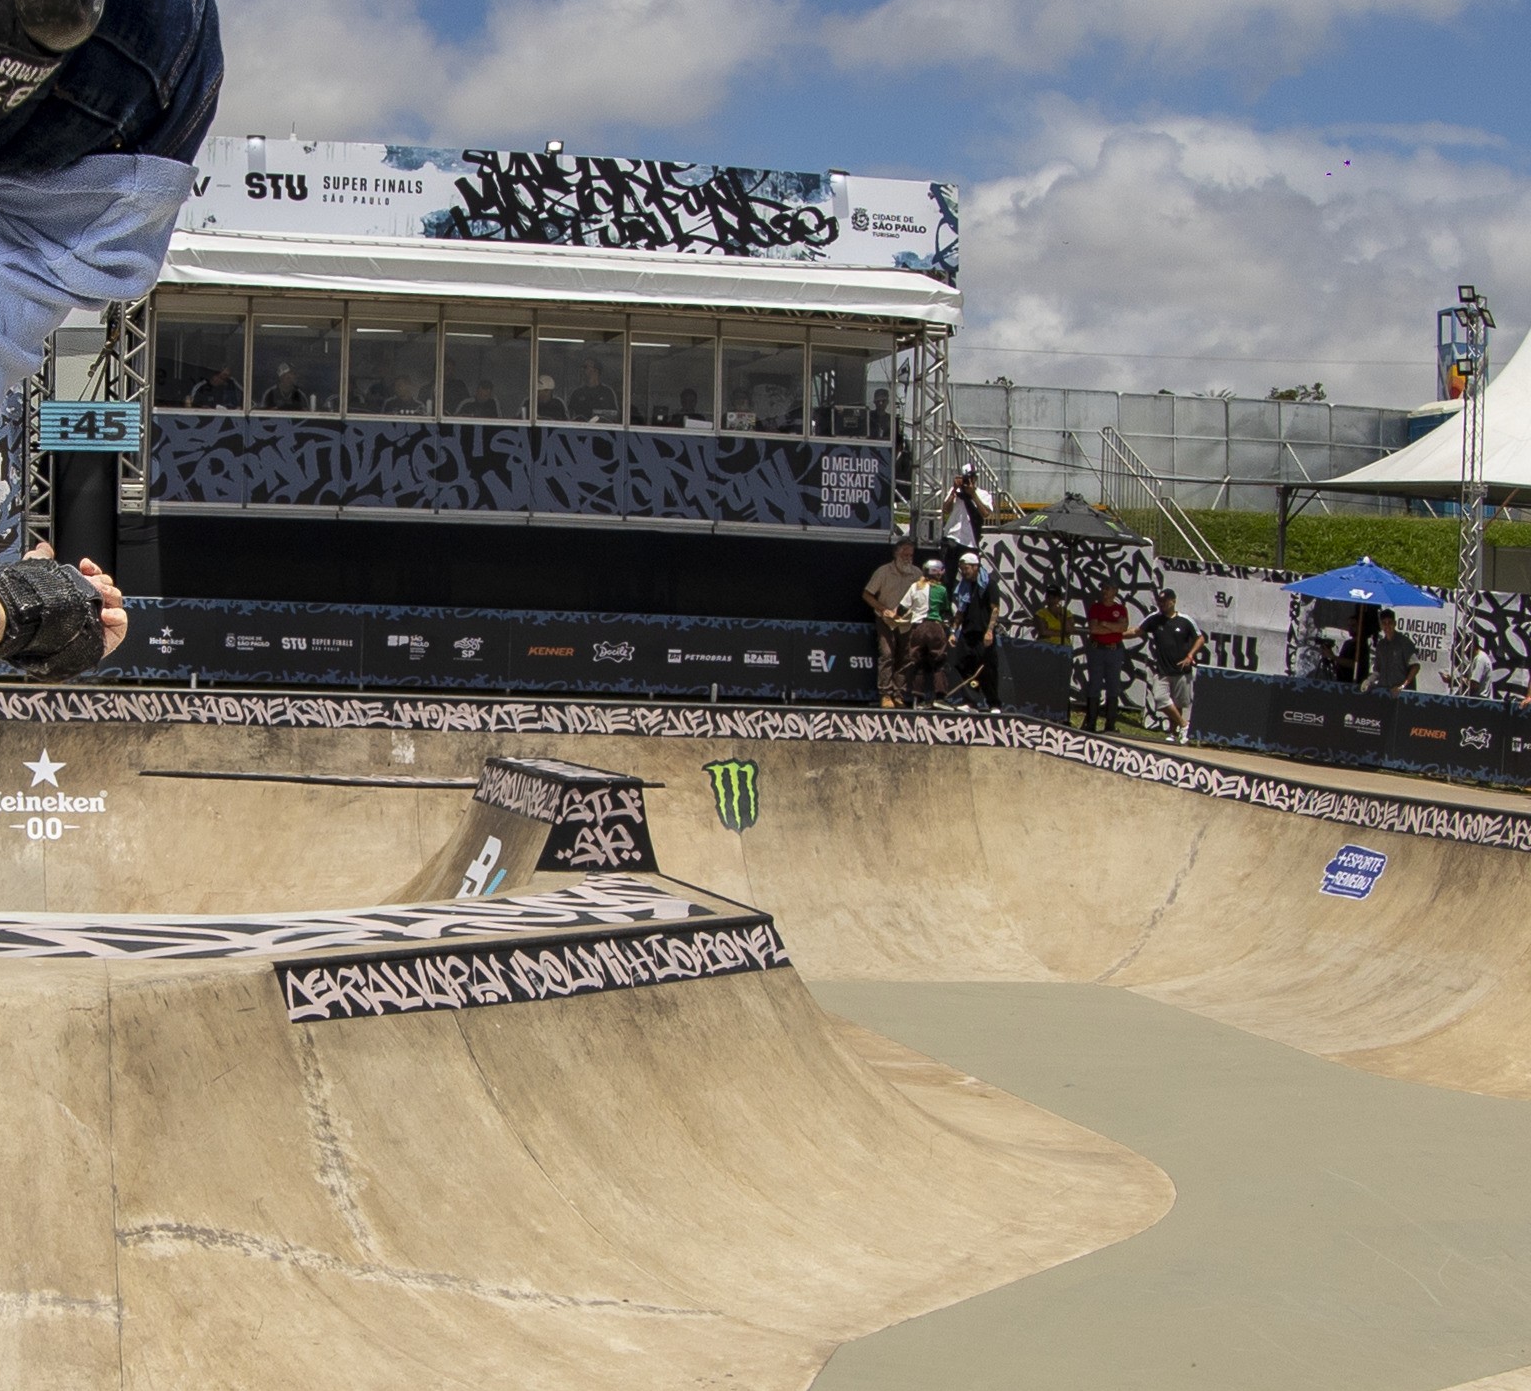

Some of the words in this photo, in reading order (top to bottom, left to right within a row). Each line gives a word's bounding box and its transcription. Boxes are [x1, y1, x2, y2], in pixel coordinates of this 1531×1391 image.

[245, 172, 308, 201] STU
[323, 176, 367, 191] SUPER
[374, 178, 423, 194] FINALS
[323, 194, 344, 203] SÃO
[352, 195, 390, 206] PAULO
[872, 214, 901, 222] CIDADE
[872, 222, 893, 230] SÃO
[895, 224, 927, 234] PAULO
[822, 457, 829, 470] O
[832, 457, 879, 474] MELHOR
[822, 472, 837, 486] DO
[839, 473, 875, 488] SKATE
[821, 489, 829, 502] O
[831, 489, 870, 504] TEMPO
[821, 504, 851, 519] TODO
[1397, 617, 1404, 630] O
[1406, 619, 1447, 636] MELHOR
[282, 638, 307, 651] STU
[1412, 633, 1443, 649] SKATE
[462, 649, 475, 659] SP
[528, 646, 574, 657] KENNER
[849, 656, 873, 668] STU
